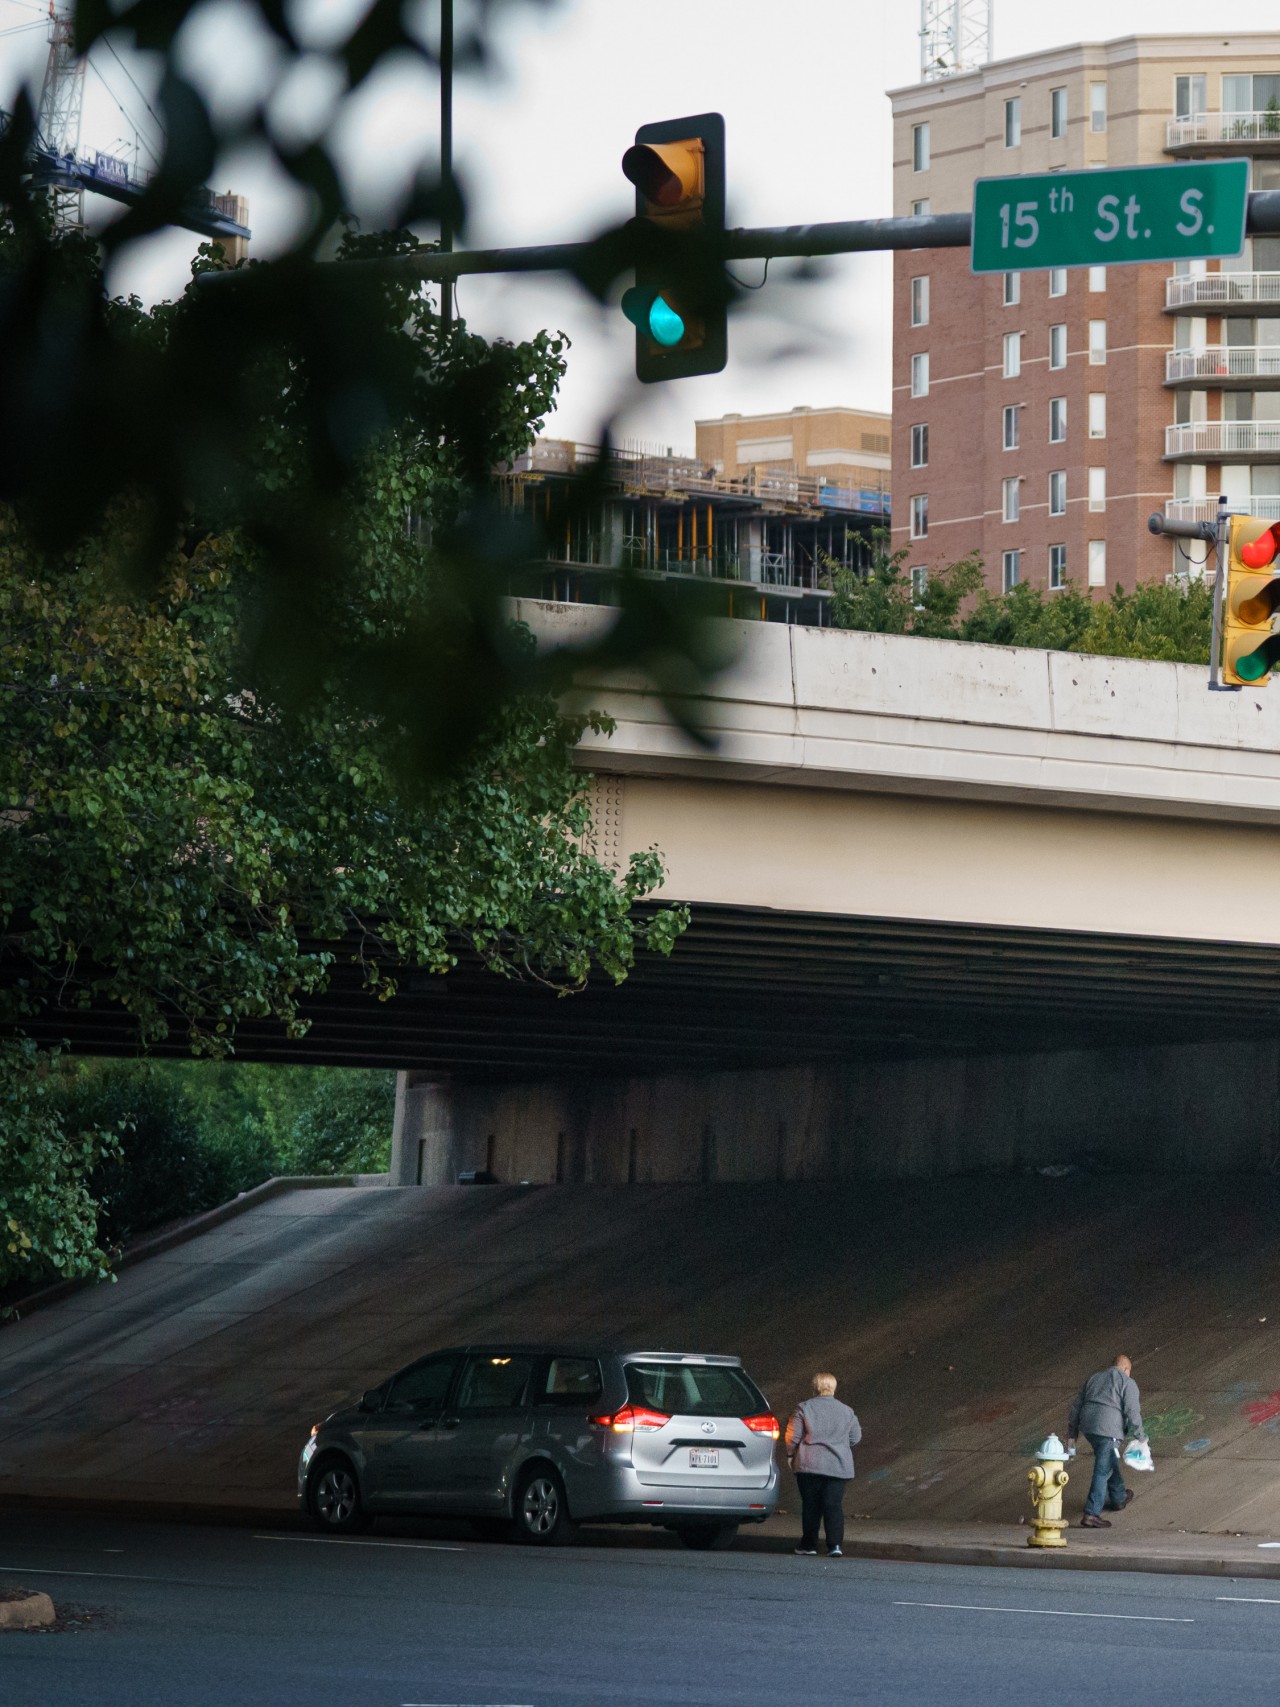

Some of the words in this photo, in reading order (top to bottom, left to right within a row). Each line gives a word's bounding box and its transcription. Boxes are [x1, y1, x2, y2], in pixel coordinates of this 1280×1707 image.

[97, 156, 126, 178] CLARK
[999, 187, 1074, 249] 15th
[1094, 193, 1152, 242] St.
[1175, 188, 1215, 236] S.
